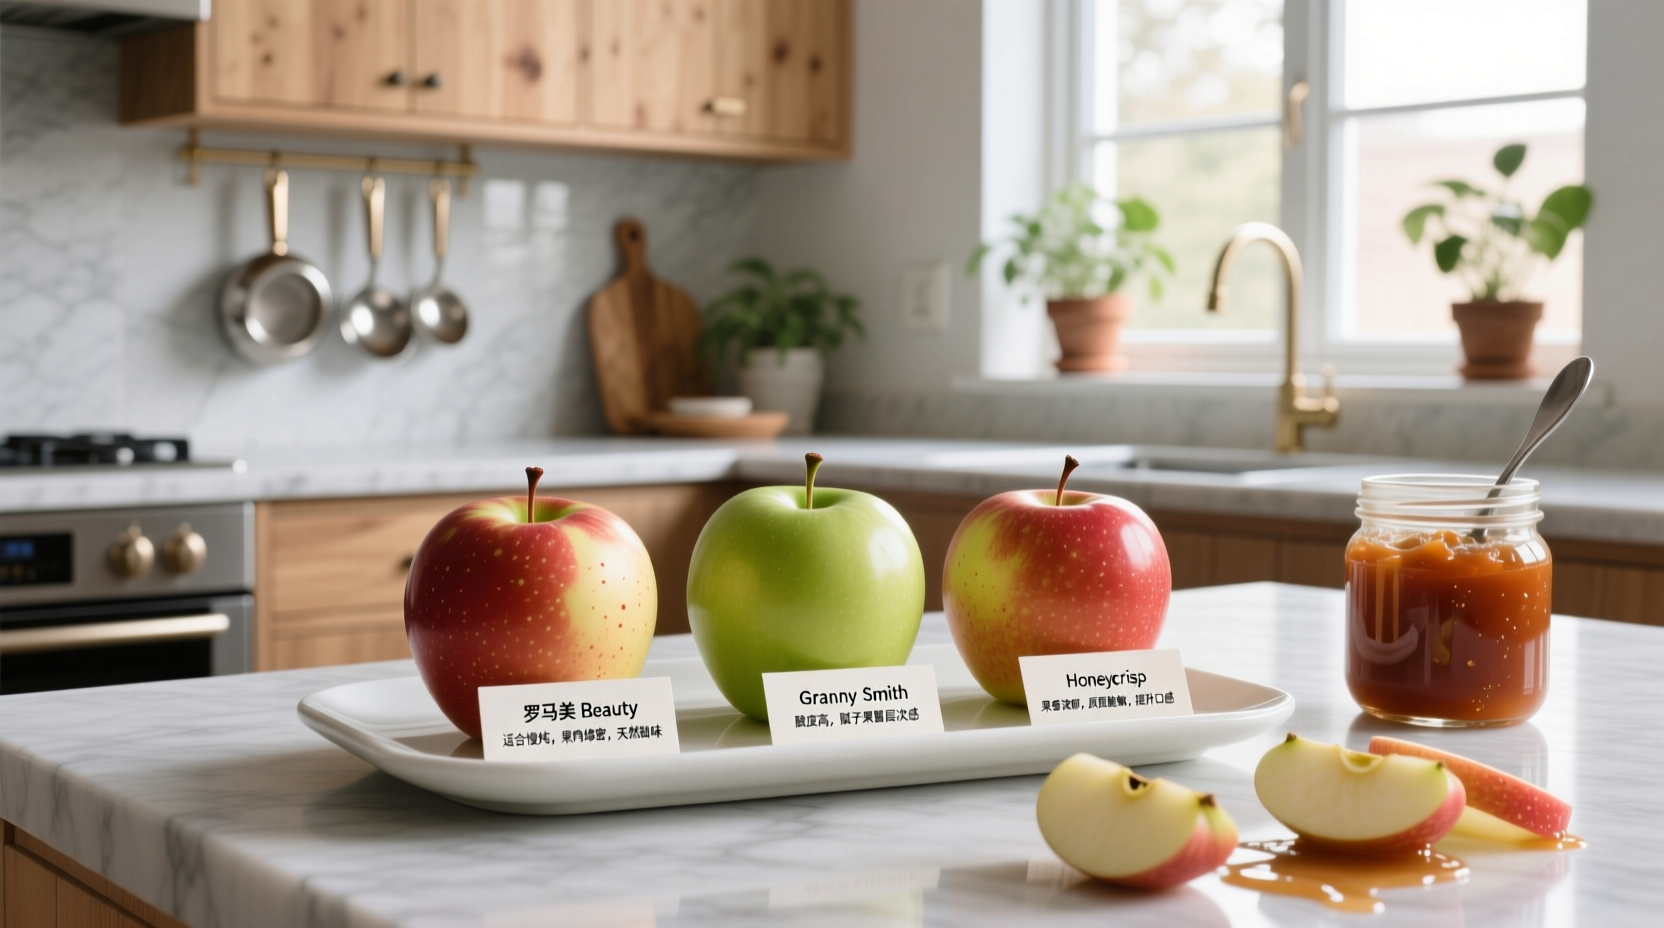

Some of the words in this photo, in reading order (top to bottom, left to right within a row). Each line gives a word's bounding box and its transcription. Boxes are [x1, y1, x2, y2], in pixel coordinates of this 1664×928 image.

[1066, 669, 1146, 689] Honeycrisp
[800, 690, 857, 707] Granny
[863, 685, 908, 702] Smith
[524, 702, 576, 723] 罗马美
[581, 702, 638, 719] Beauty
